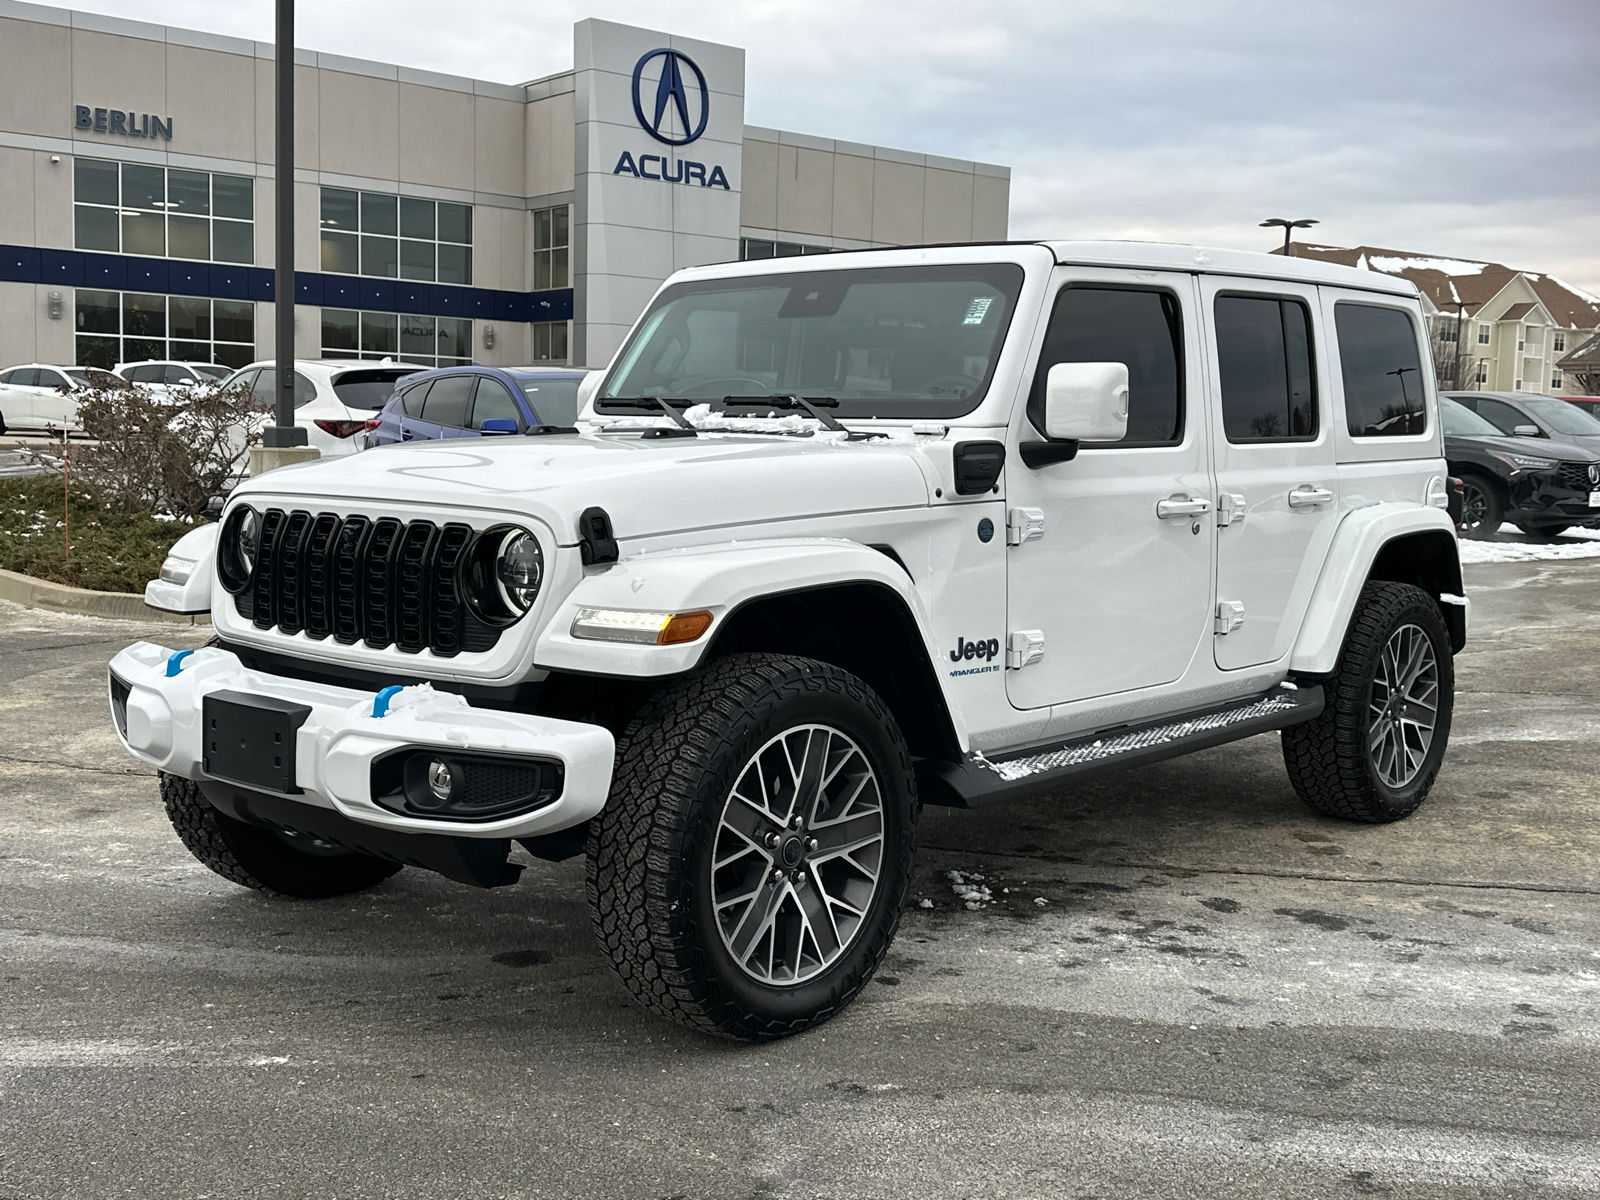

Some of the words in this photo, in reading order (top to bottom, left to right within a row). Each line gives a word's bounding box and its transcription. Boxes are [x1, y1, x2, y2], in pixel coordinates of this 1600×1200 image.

[75, 105, 173, 140] BERLIN
[612, 150, 731, 191] ACURA
[950, 636, 999, 662] Jeep
[950, 665, 992, 677] WRANGLER
